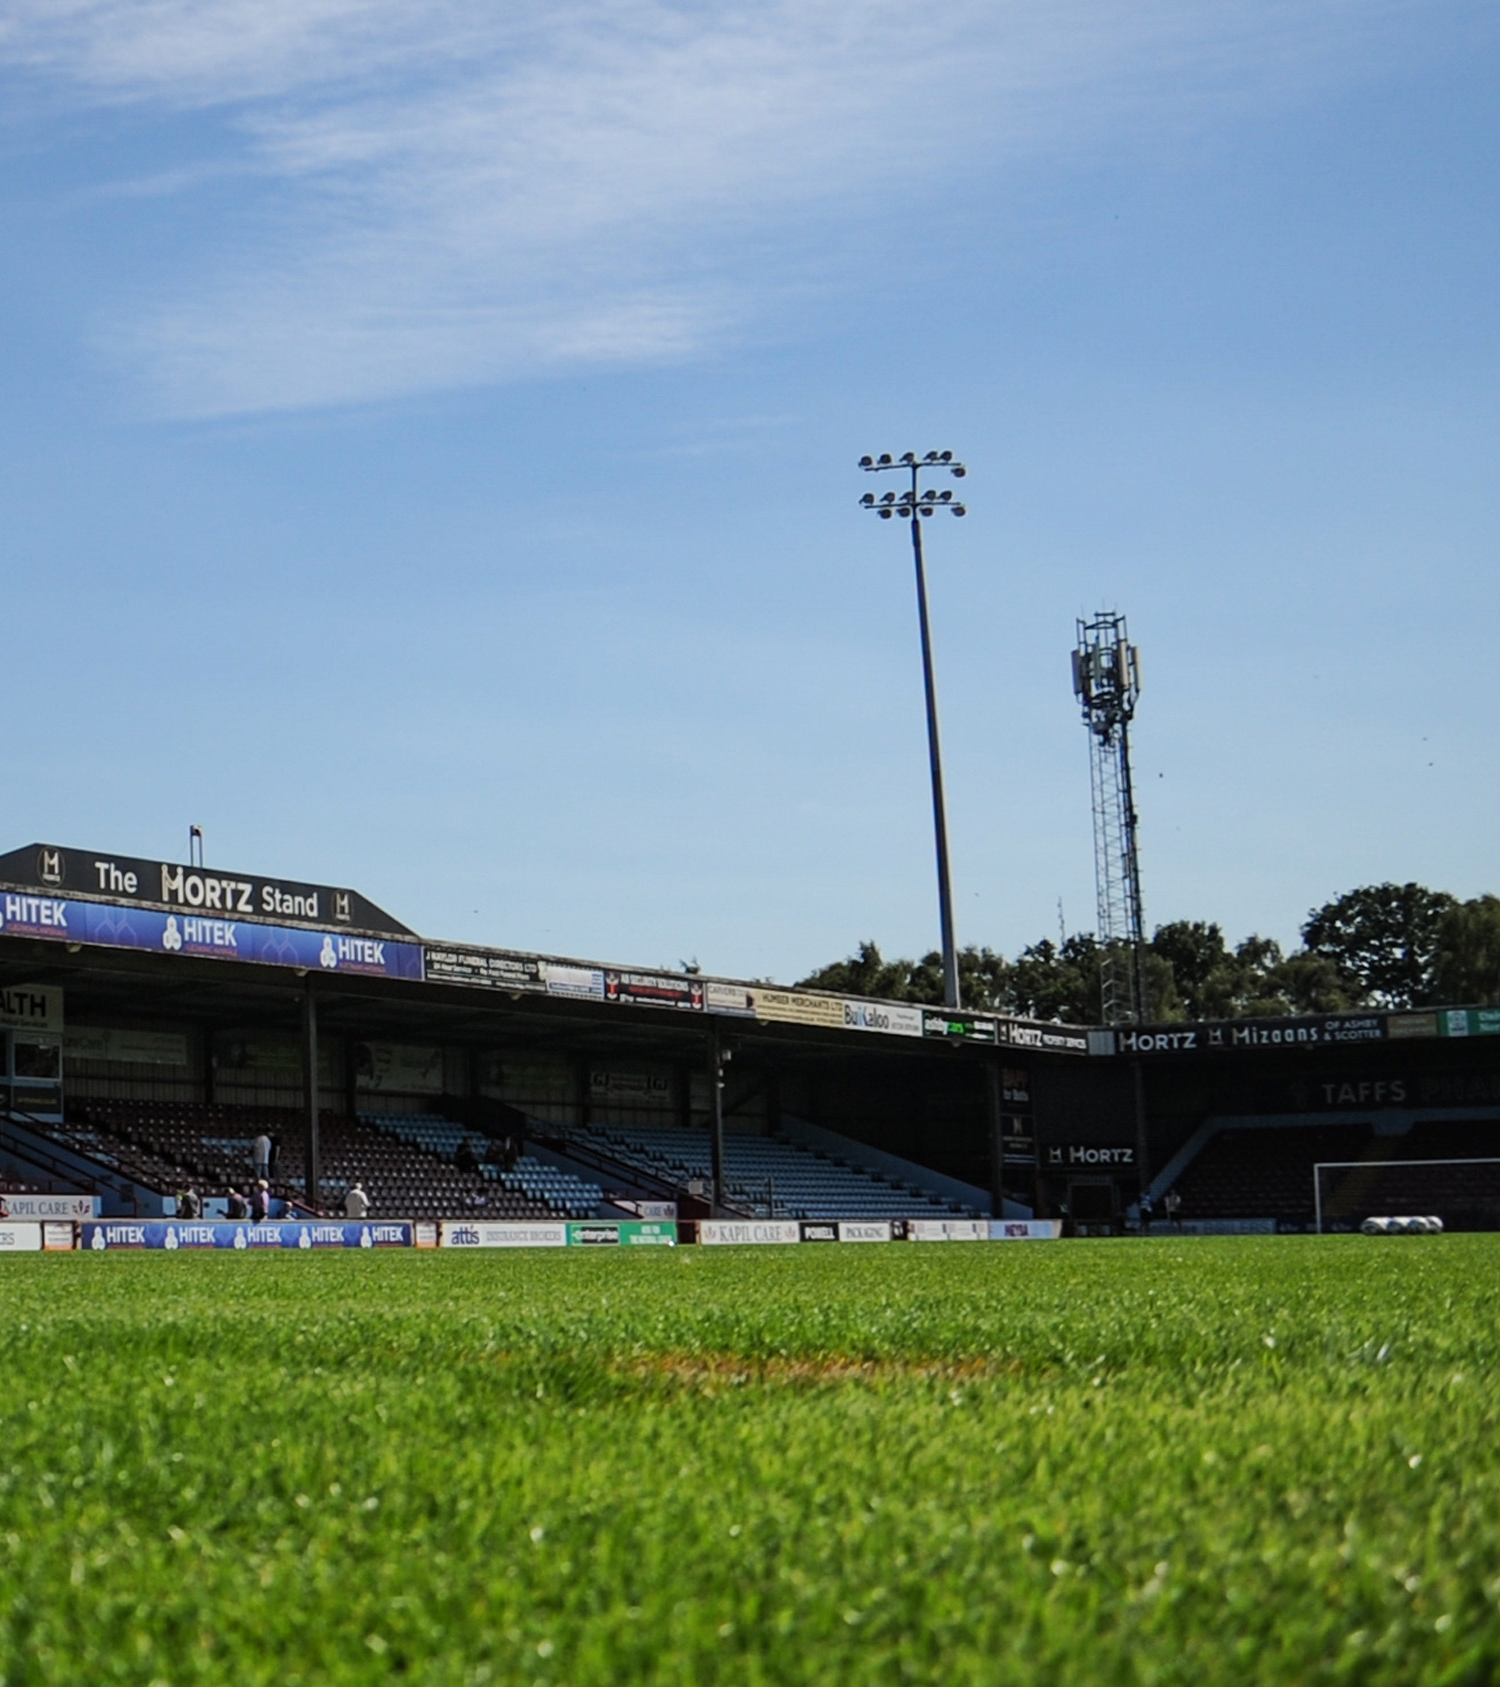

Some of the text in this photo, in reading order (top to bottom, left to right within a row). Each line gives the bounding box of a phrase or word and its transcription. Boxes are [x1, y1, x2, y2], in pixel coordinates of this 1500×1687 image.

[95, 862, 137, 894] The
[263, 885, 318, 918] Stand
[6, 895, 68, 927] HITEK
[184, 917, 238, 947] HITEK
[339, 936, 385, 966] HITEK
[1322, 1080, 1407, 1104] TAFFS
[38, 1200, 68, 1215] CARE
[106, 1227, 145, 1243] HITEK
[179, 1227, 216, 1244] HITEK
[247, 1227, 281, 1243] HITEK
[311, 1226, 344, 1243] HITEK
[372, 1226, 404, 1242] HITEK
[753, 1226, 781, 1240] CARE
